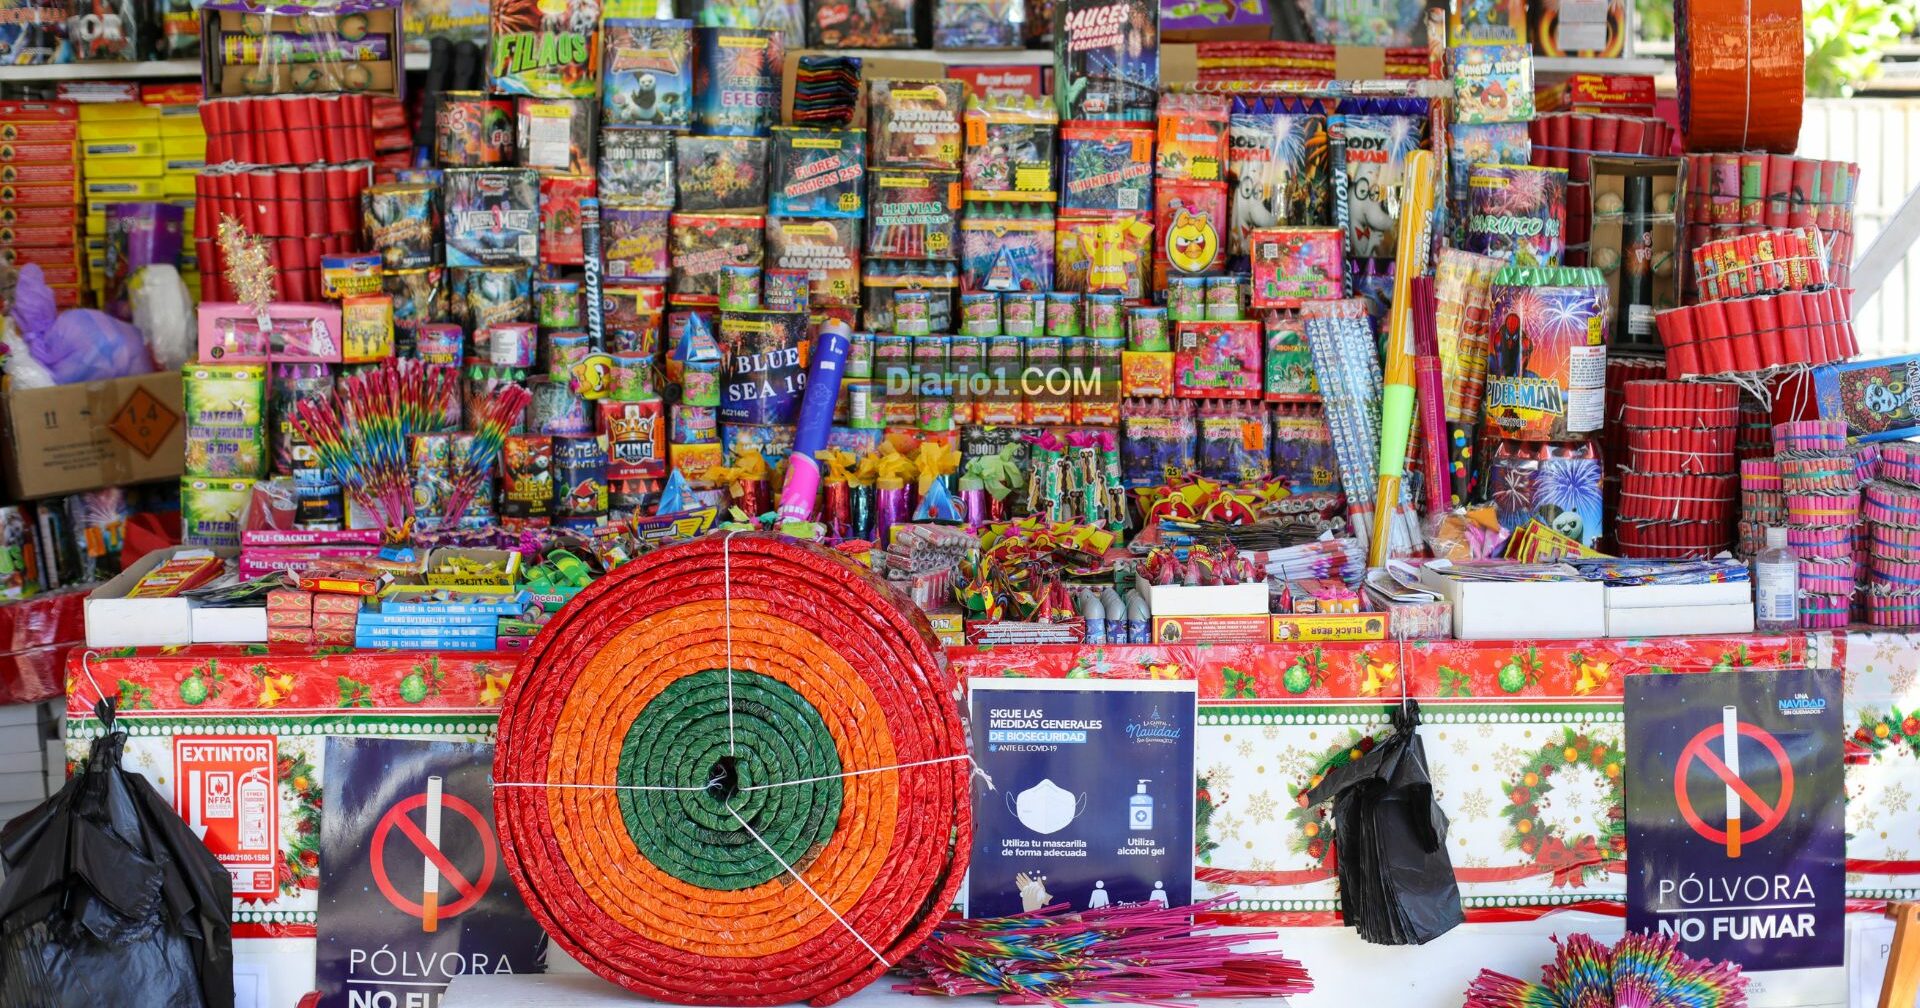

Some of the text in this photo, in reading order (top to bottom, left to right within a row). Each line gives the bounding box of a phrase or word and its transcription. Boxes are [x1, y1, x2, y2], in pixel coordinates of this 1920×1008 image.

[1064, 3, 1130, 32] SAUCES
[1073, 23, 1119, 40] DORADOS
[1075, 34, 1125, 51] CRACKLING
[893, 109, 955, 122] FESTIVAL
[606, 148, 663, 160] GOOD NEWS
[795, 155, 841, 180] FLORES
[1068, 163, 1152, 194] THUNDER KING
[785, 174, 839, 198] MAGICAS
[843, 194, 855, 203] 25
[882, 202, 942, 216] LLUVIAS
[1468, 214, 1544, 236] NARUTO
[784, 246, 846, 257] FESTIVAL
[584, 255, 604, 334] Roman
[737, 348, 799, 374] BLUE
[728, 380, 777, 402] SEA
[200, 410, 244, 423] BATERIA
[615, 443, 651, 458] KING
[968, 443, 995, 455] GOOD
[1167, 468, 1177, 476] 25
[251, 533, 315, 543] PILI-CRACKER
[454, 577, 495, 586] ABEJITAS
[1311, 626, 1363, 635] BLACK BEAR
[1778, 698, 1826, 709] NAVIDAD
[990, 709, 1043, 719] SIGUE LAS
[989, 719, 1102, 730] MEDIDAS GENERALES
[1125, 723, 1181, 739] Navidad
[989, 731, 1086, 742] DE BIOSEGURIDAD
[182, 746, 268, 762] EXTINTOR
[998, 744, 1057, 752] ANTE EL COVID-19
[1002, 838, 1087, 848] Utiliza tu mascarilla
[1127, 838, 1155, 847] Utiliza
[1001, 848, 1087, 857] de forma adecuada
[1117, 847, 1165, 857] alcohol gel
[1659, 873, 1816, 904] PÓLVORA
[1658, 914, 1816, 942] NO FUMAR
[350, 945, 515, 978] PÓLVORA
[349, 990, 397, 1008] NO
